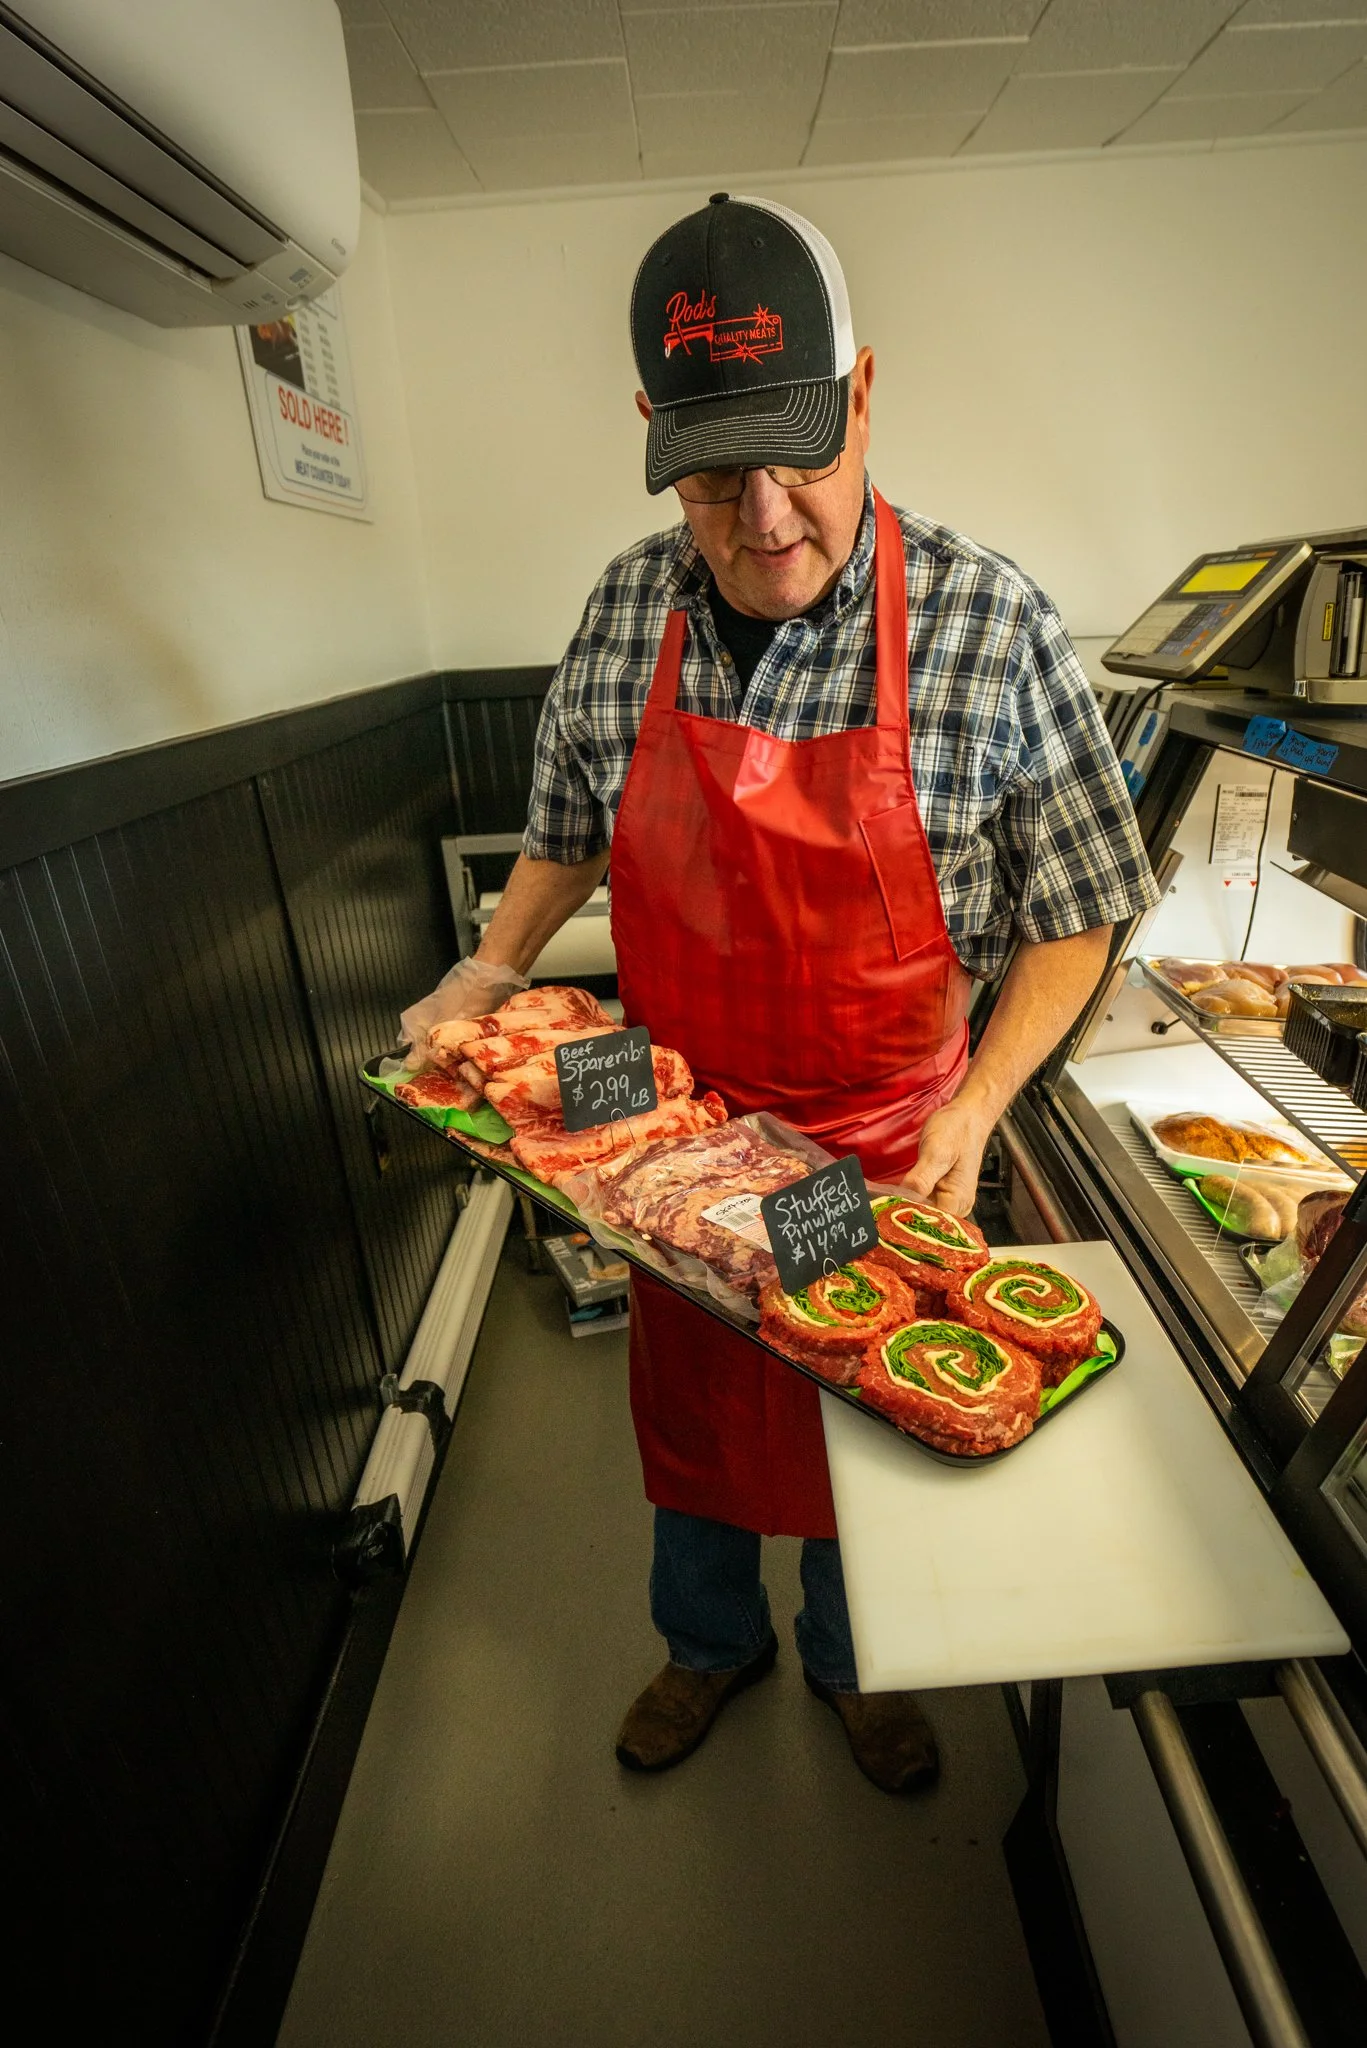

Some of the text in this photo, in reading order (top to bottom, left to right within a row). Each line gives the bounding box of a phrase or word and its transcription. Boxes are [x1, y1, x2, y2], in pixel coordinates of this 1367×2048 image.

[666, 289, 716, 355] Rod's
[714, 327, 777, 345] QUALITY MEATS
[278, 384, 312, 430] SOLD
[560, 1040, 595, 1062] Beef
[631, 1088, 650, 1108] LB
[775, 1171, 852, 1228] Stuffed
[782, 1191, 861, 1246] Pinwheels
[851, 1227, 869, 1248] LB
